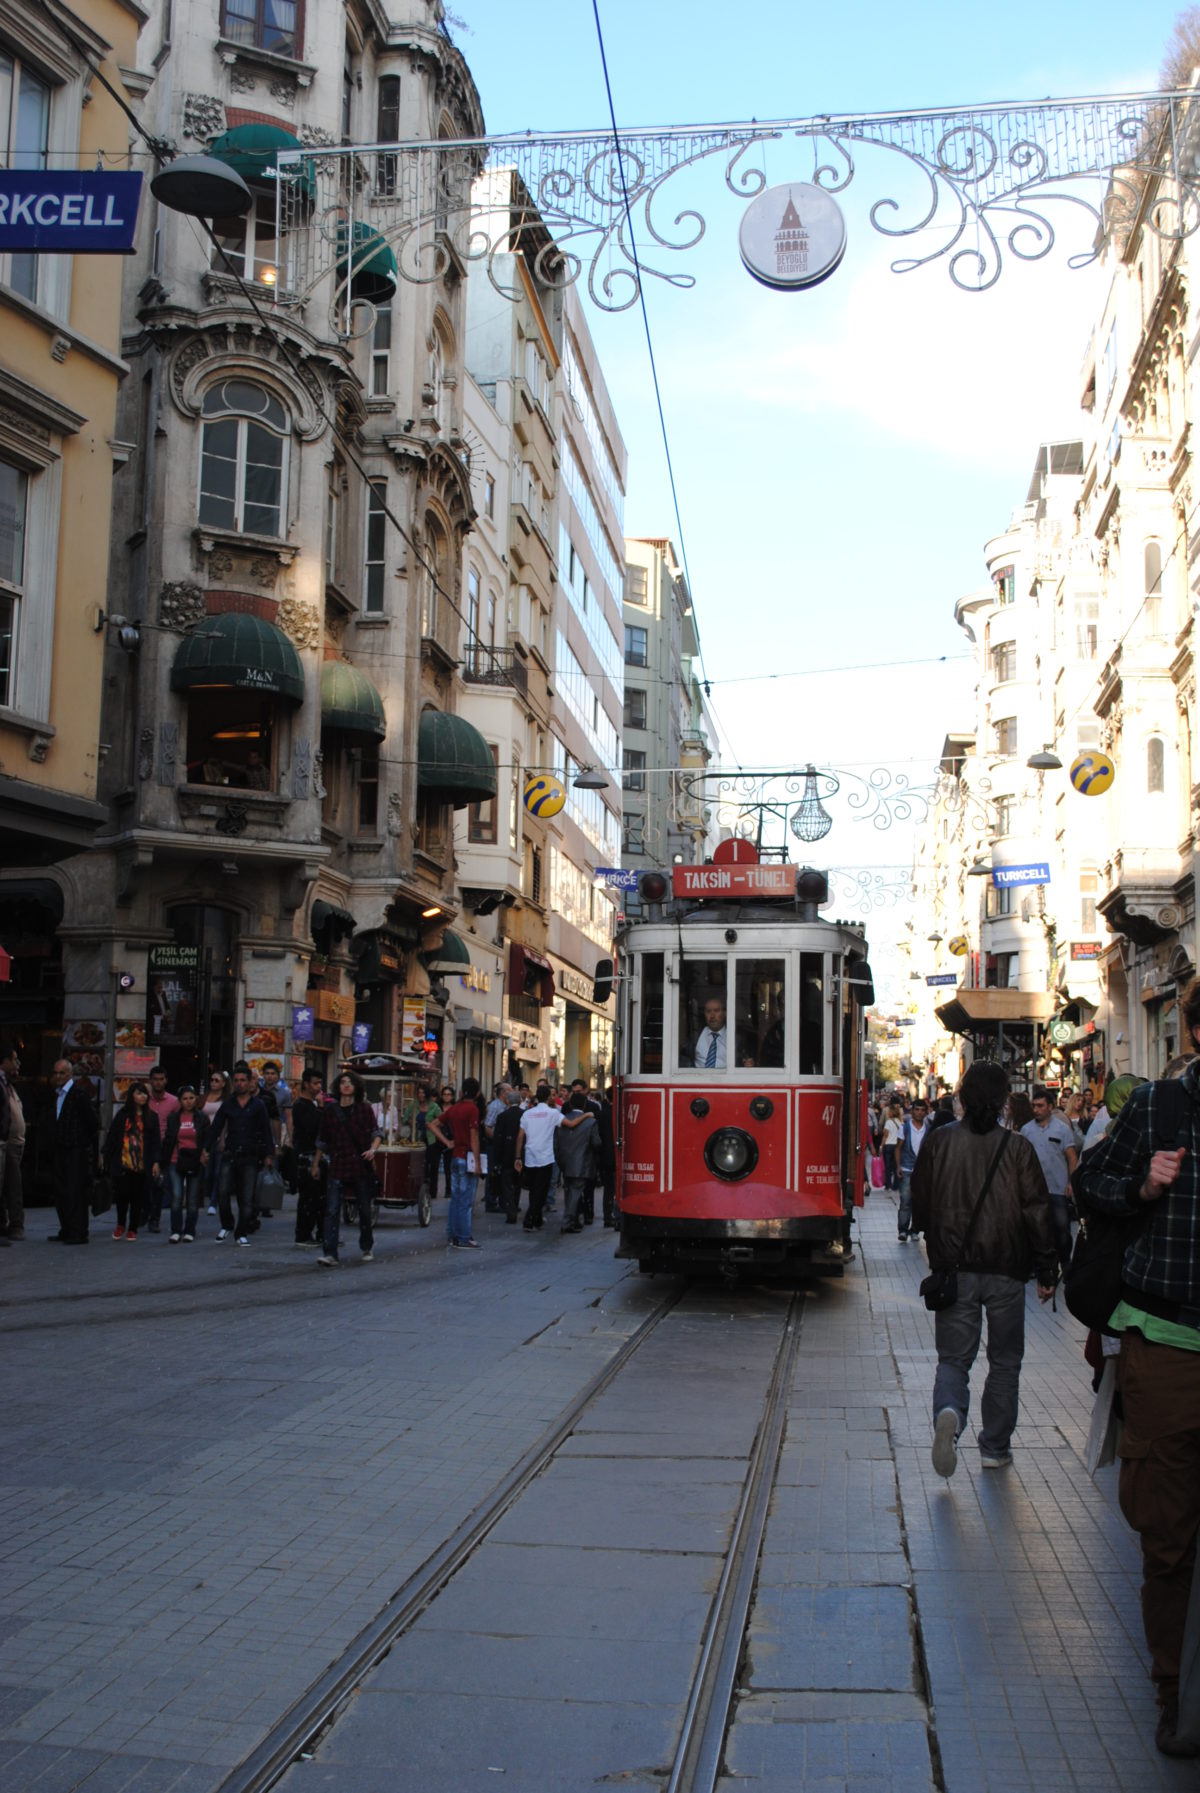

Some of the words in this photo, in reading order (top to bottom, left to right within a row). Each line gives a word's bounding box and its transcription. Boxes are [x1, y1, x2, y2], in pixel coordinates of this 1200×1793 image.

[246, 668, 272, 683] M&N
[732, 841, 738, 862] 1
[684, 868, 731, 889] TAKSİM
[995, 867, 1049, 882] TURKCELL
